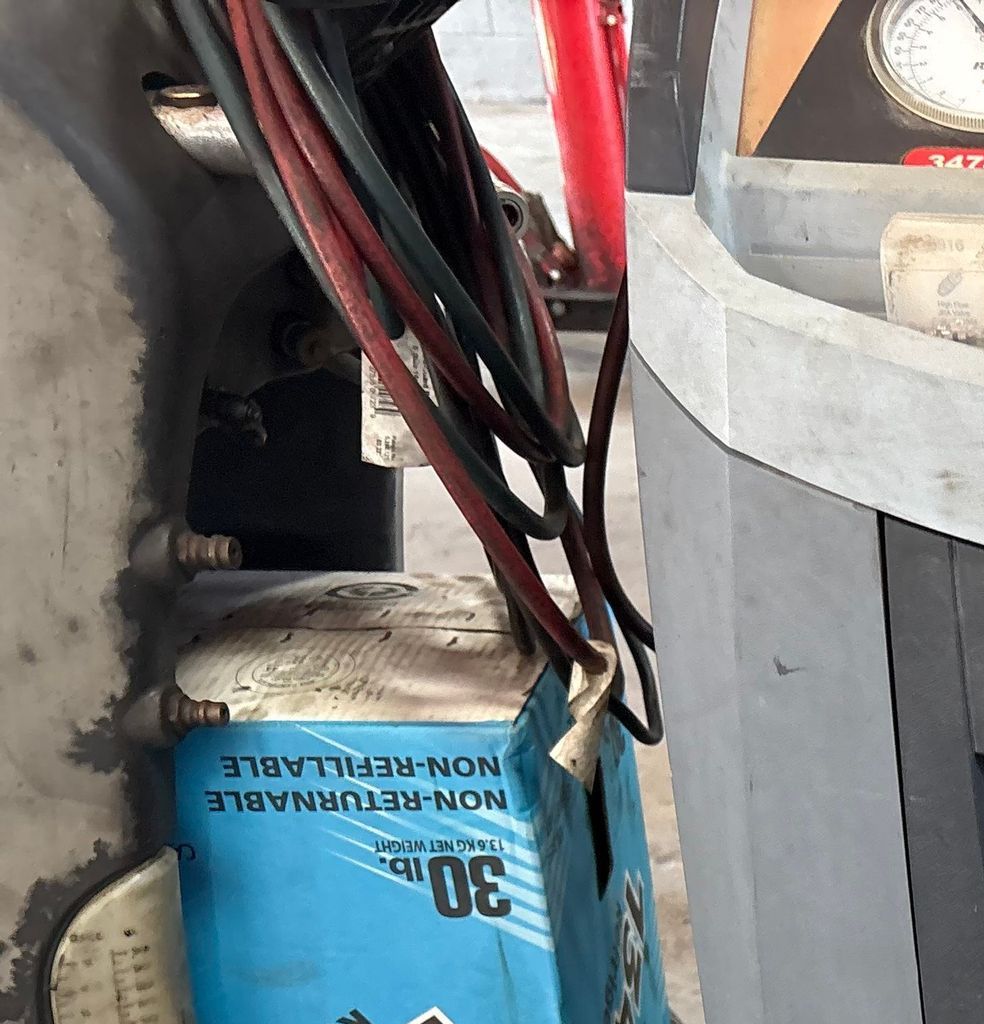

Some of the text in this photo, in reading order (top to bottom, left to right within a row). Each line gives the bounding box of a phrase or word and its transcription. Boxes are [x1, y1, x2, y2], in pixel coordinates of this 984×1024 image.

[220, 756, 501, 778] NON-REFILLABLE
[205, 789, 508, 812] NON-RETURNABLE
[375, 839, 505, 853] 13.6 KG NET WEIGHT
[379, 855, 512, 918] 30 lb.
